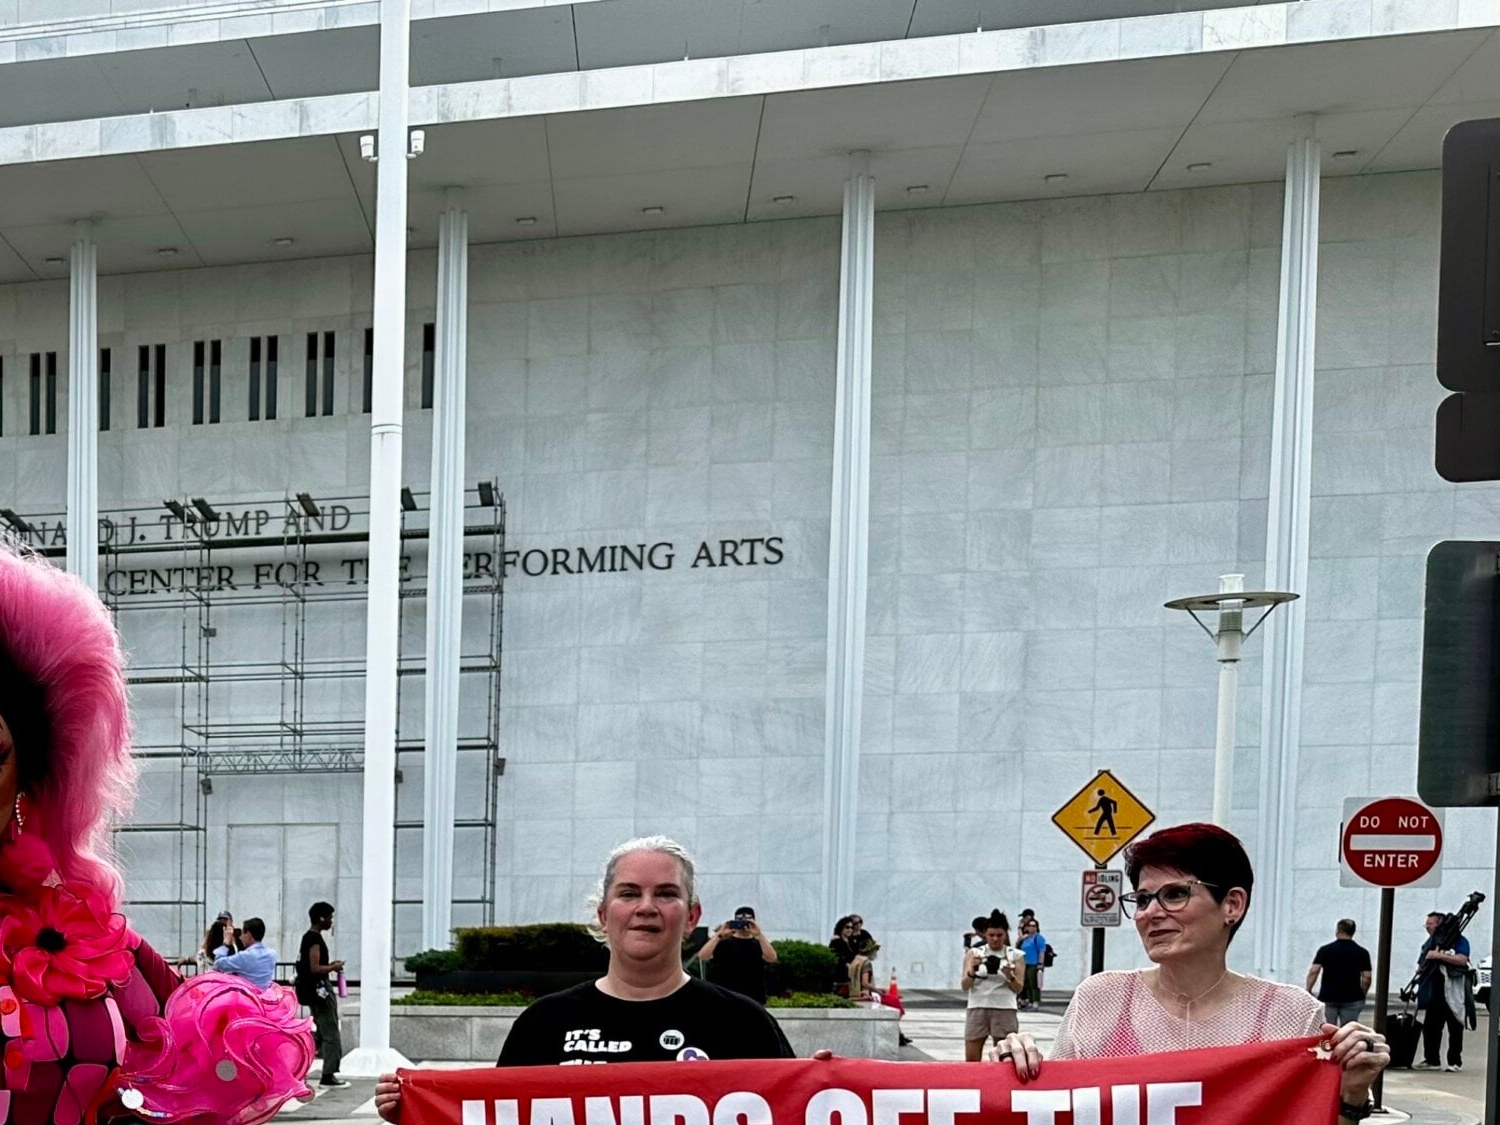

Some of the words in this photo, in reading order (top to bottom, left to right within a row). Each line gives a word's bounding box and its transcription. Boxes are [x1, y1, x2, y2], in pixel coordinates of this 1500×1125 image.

[282, 504, 352, 534] AND
[104, 565, 239, 597] CENTER
[253, 560, 325, 590] FOR
[462, 542, 676, 581] ERFORMING
[690, 536, 785, 569] ARTS
[1359, 815, 1382, 829] DO
[1397, 815, 1430, 829] NOT
[1363, 853, 1420, 869] ENTER
[564, 1028, 602, 1042] IT'S
[563, 1040, 633, 1053] CALLED
